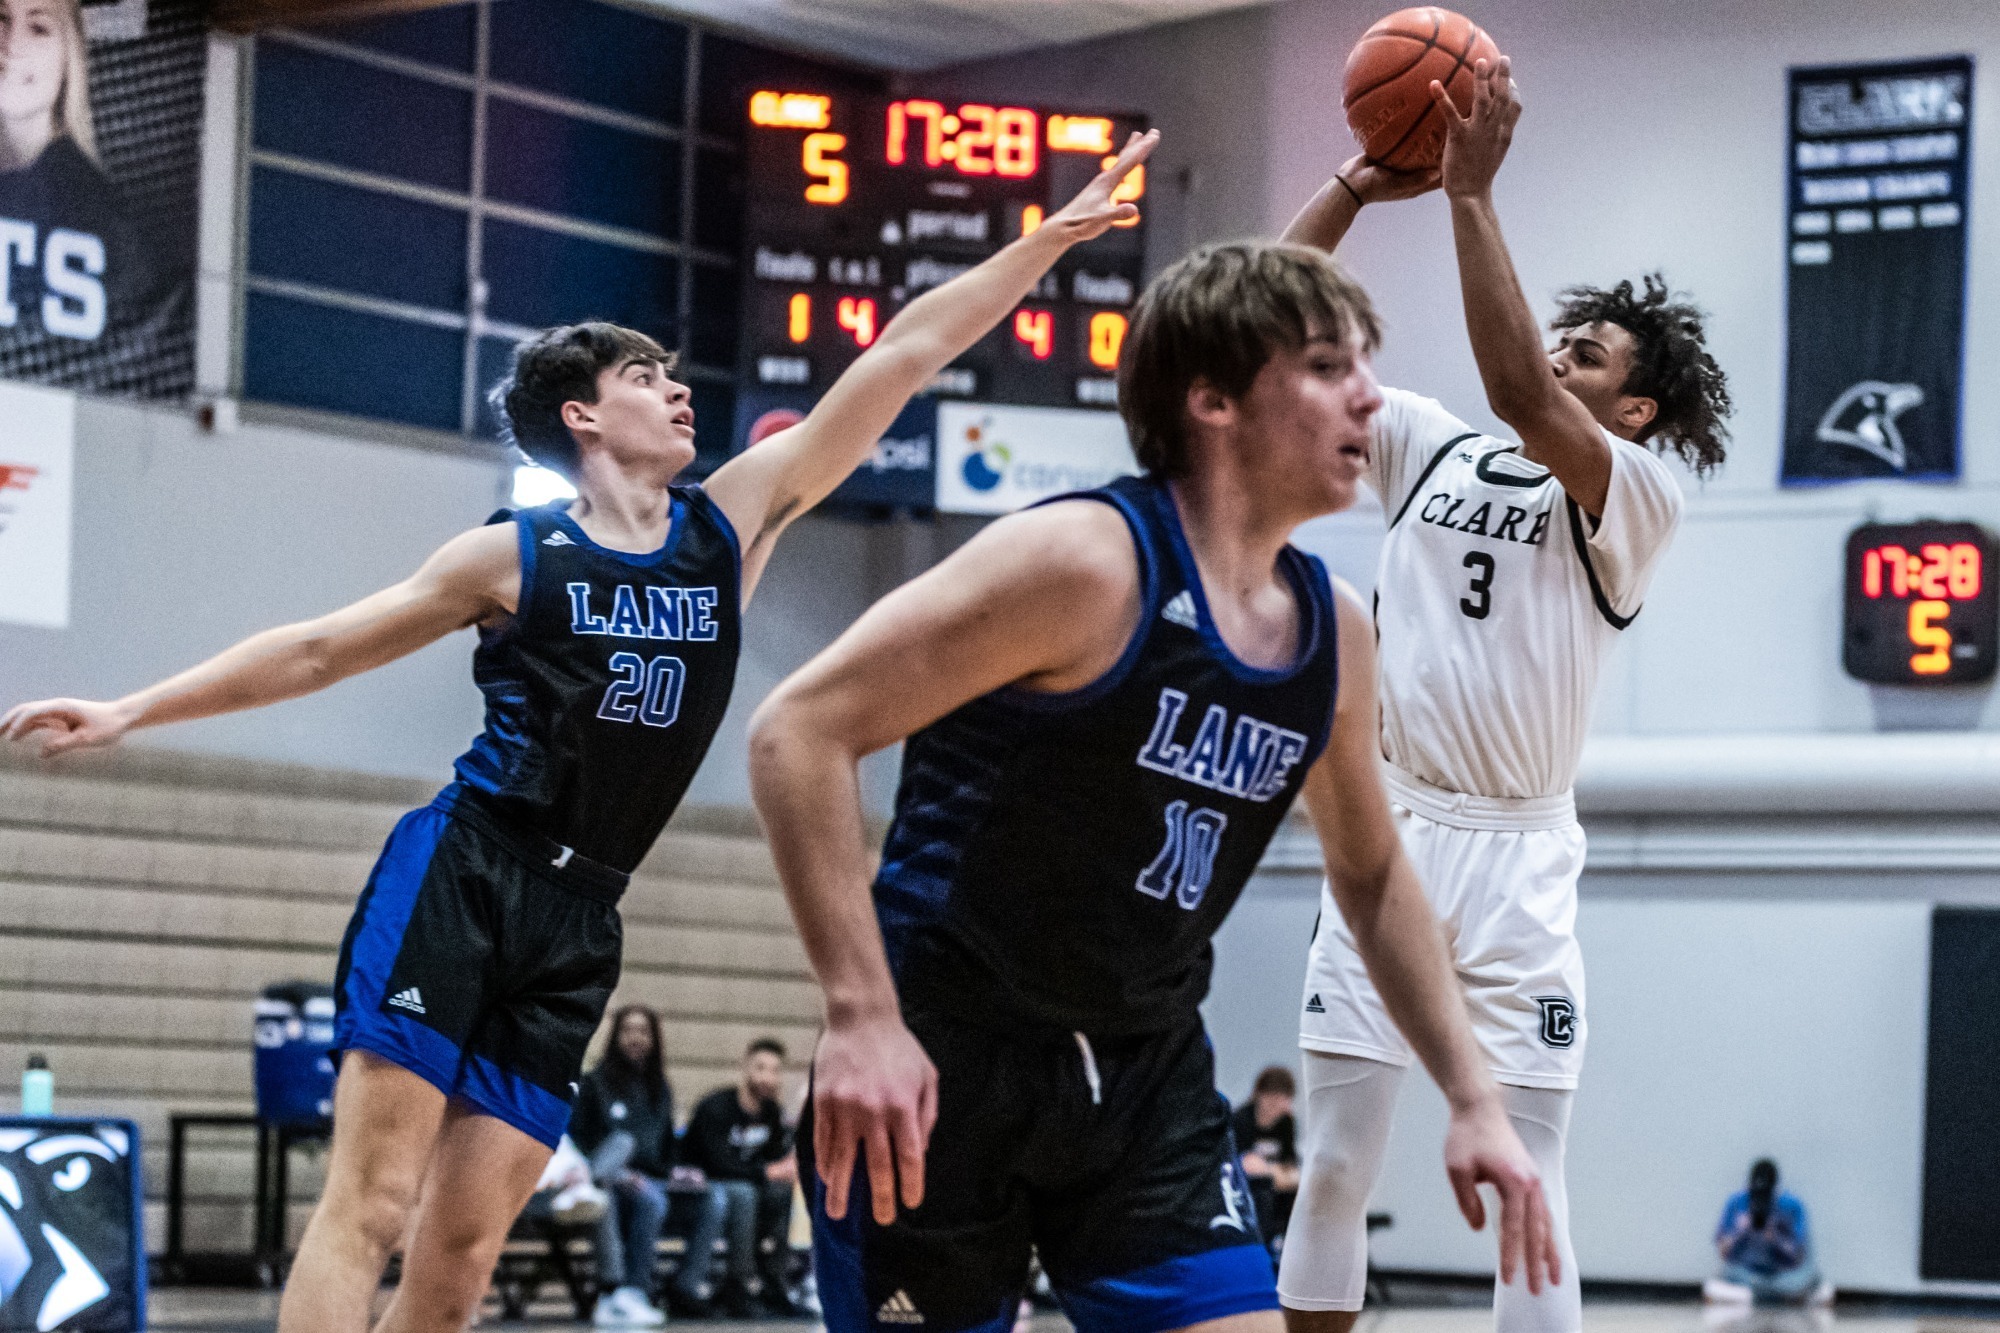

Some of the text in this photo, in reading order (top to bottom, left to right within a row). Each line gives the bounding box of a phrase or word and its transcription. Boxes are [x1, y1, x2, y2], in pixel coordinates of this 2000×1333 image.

[802, 132, 849, 204] 5
[885, 99, 1039, 178] 17:28
[789, 292, 811, 343] 1
[837, 296, 878, 347] 4
[1014, 309, 1054, 360] 4
[1459, 550, 1495, 620] 3
[1862, 542, 1982, 600] 17:28
[567, 582, 718, 641] LANE
[1908, 599, 1952, 674] 5
[596, 651, 686, 728] 20
[1136, 687, 1308, 801] LANE
[1135, 799, 1228, 910] 10
